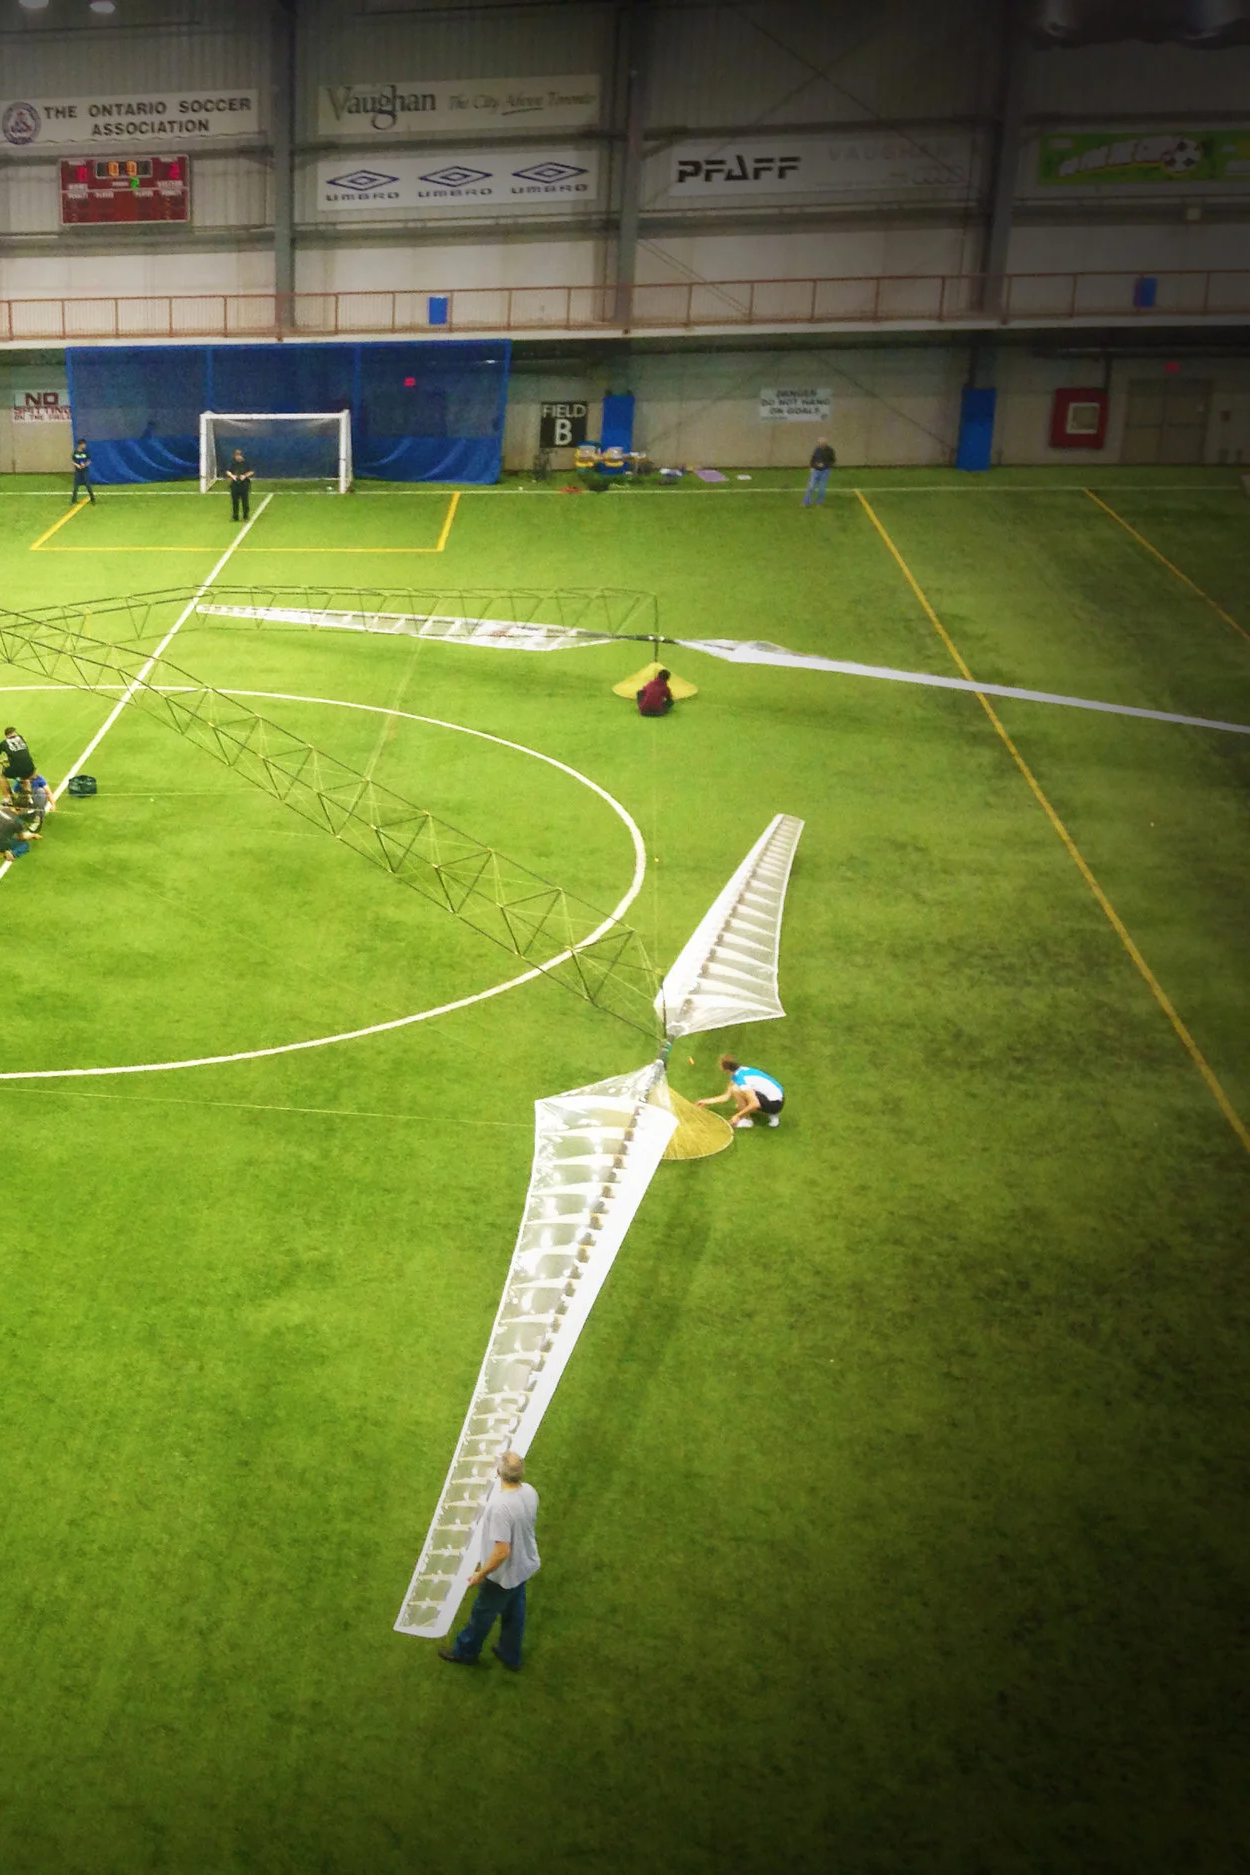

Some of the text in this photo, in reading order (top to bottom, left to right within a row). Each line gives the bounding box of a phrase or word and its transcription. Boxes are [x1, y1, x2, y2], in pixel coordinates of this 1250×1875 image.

[43, 97, 252, 120] THE ONTARIO SOCCER
[327, 84, 437, 130] Vaughan
[91, 119, 210, 136] ASSOCIATION
[677, 154, 801, 183] PFAFF
[325, 191, 400, 202] UMBRO
[417, 187, 493, 198] UMBRO
[511, 183, 589, 195] UMBRO
[25, 392, 59, 406] NO
[542, 404, 587, 418] FIELD
[555, 418, 572, 445] B
